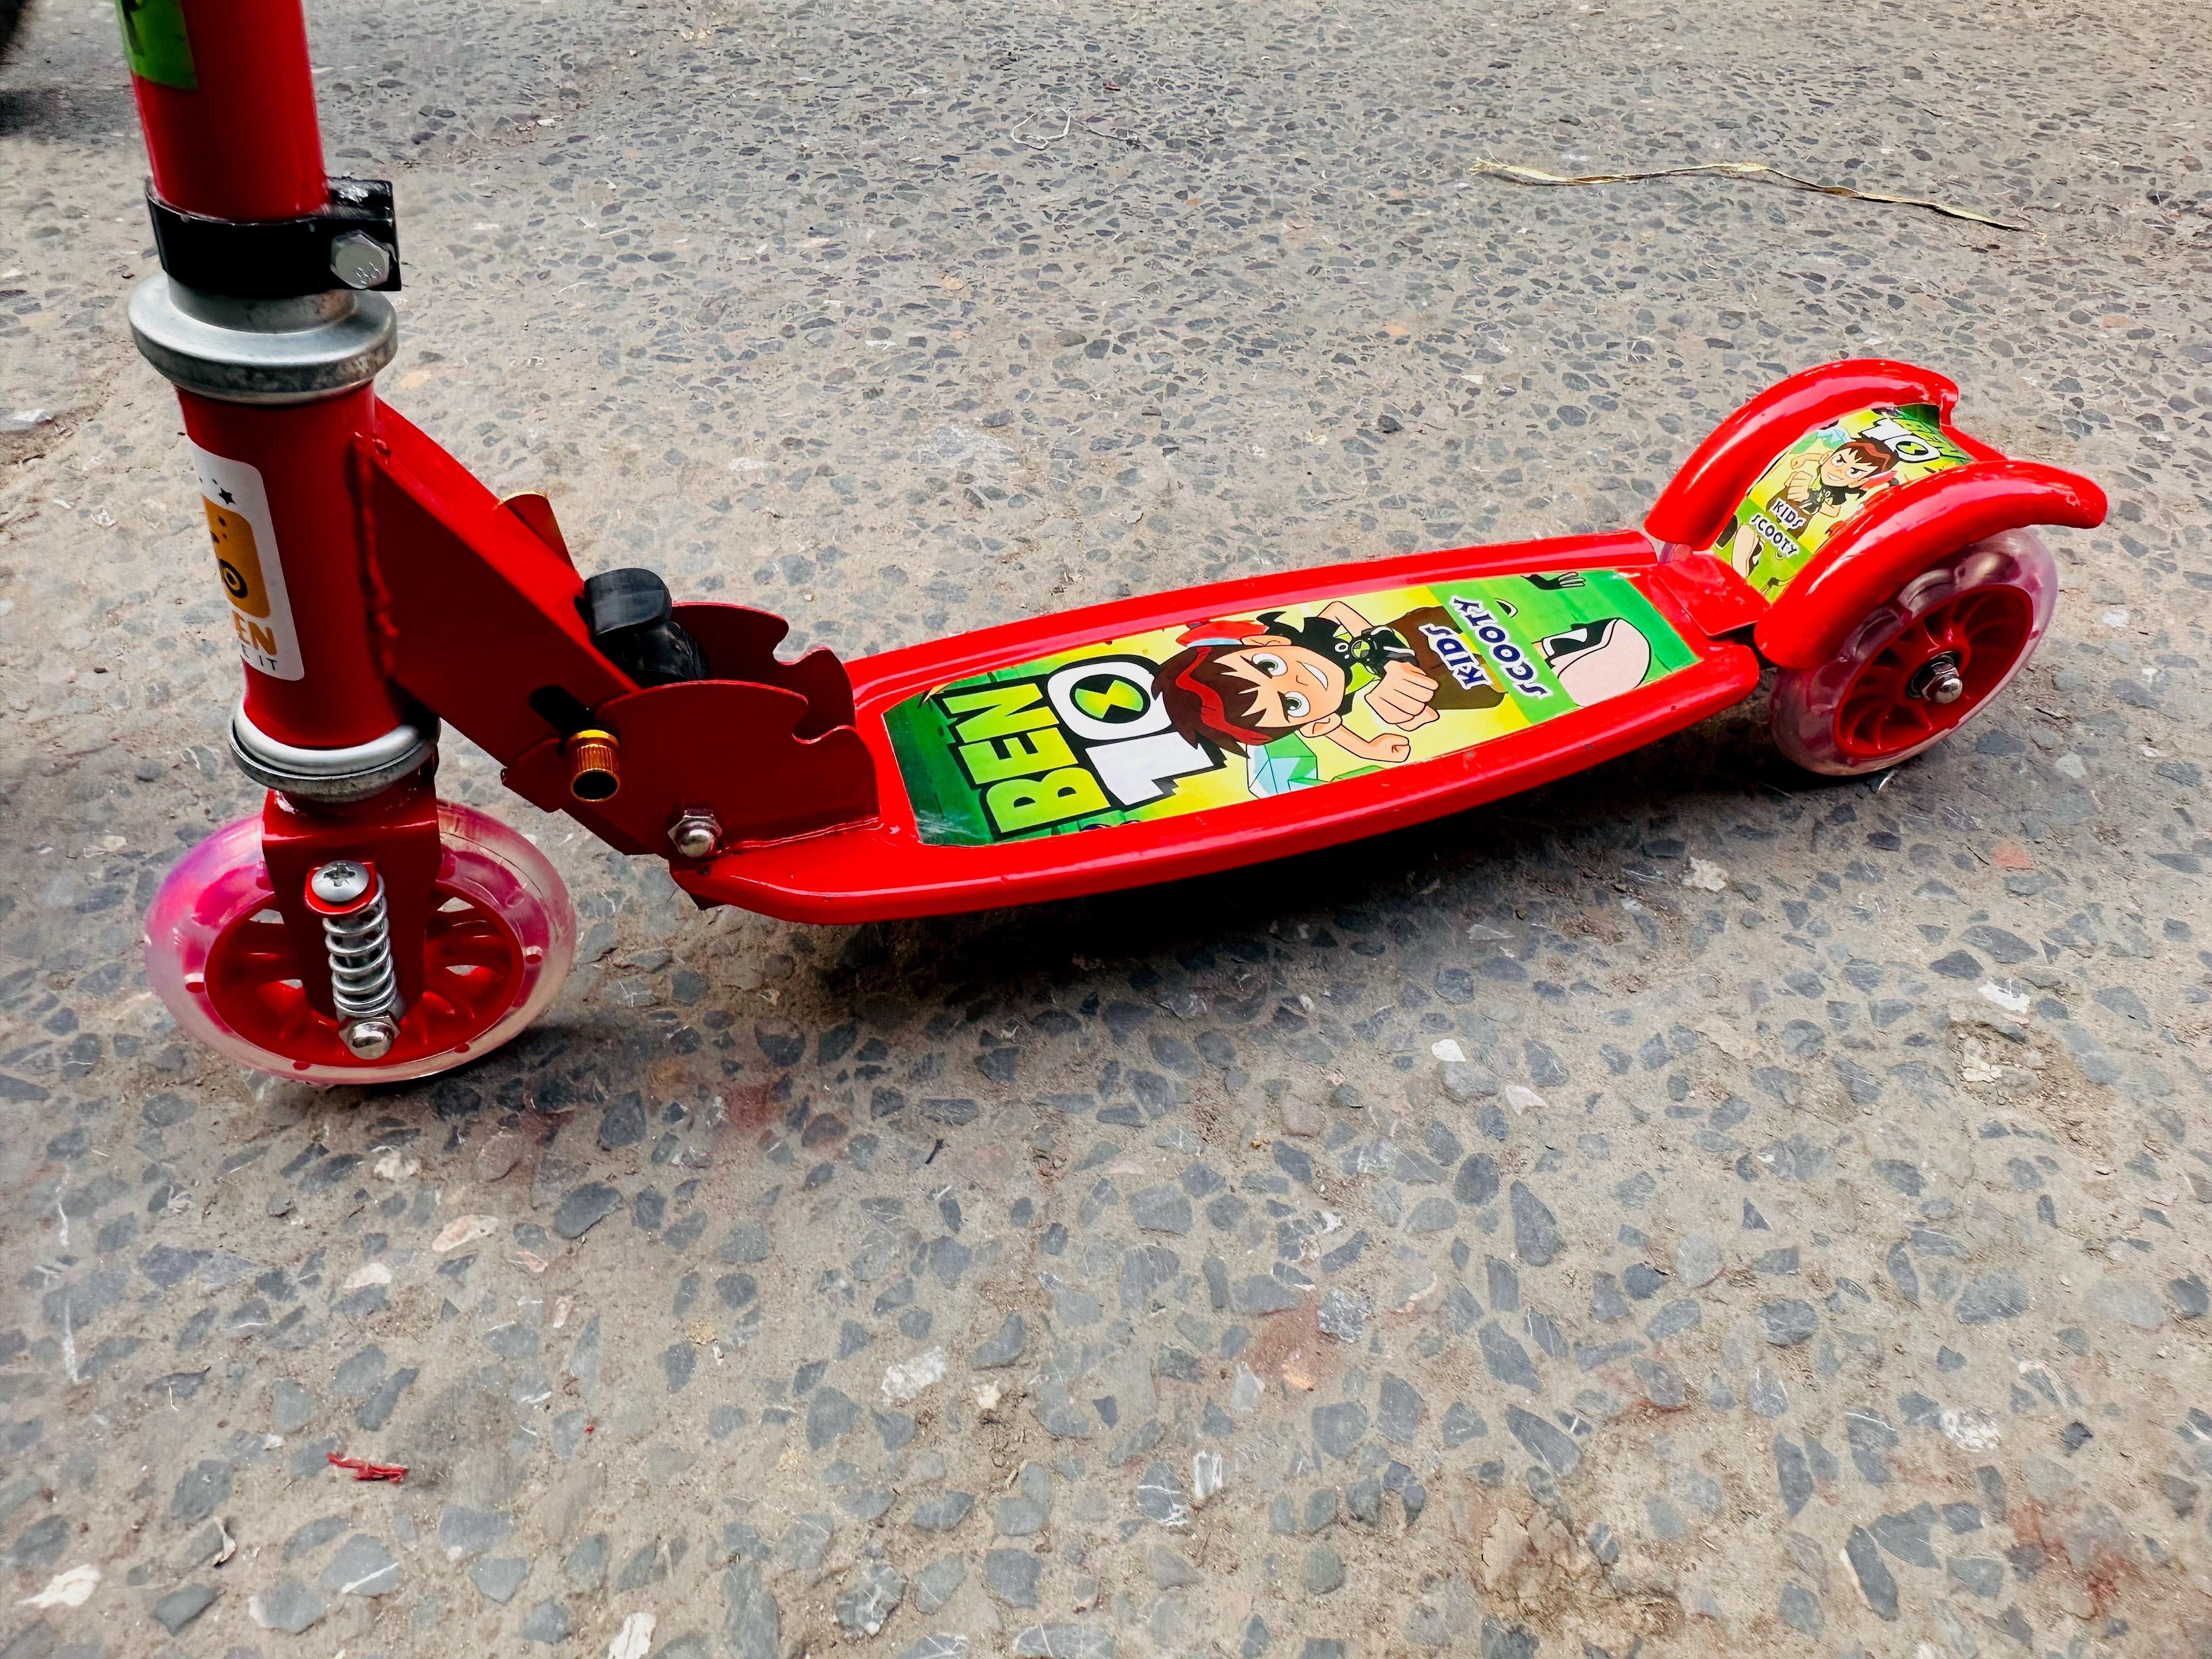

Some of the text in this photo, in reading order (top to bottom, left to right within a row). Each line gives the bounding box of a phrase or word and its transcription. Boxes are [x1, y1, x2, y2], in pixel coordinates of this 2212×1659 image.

[1751, 514, 1798, 556] SCOOTY
[1772, 500, 1804, 527] KIDS
[232, 610, 278, 656] EN
[1422, 625, 1489, 687] KIDS
[1452, 597, 1549, 697] SCOOTY
[941, 681, 1113, 834] BEN
[1046, 661, 1215, 807] 10
